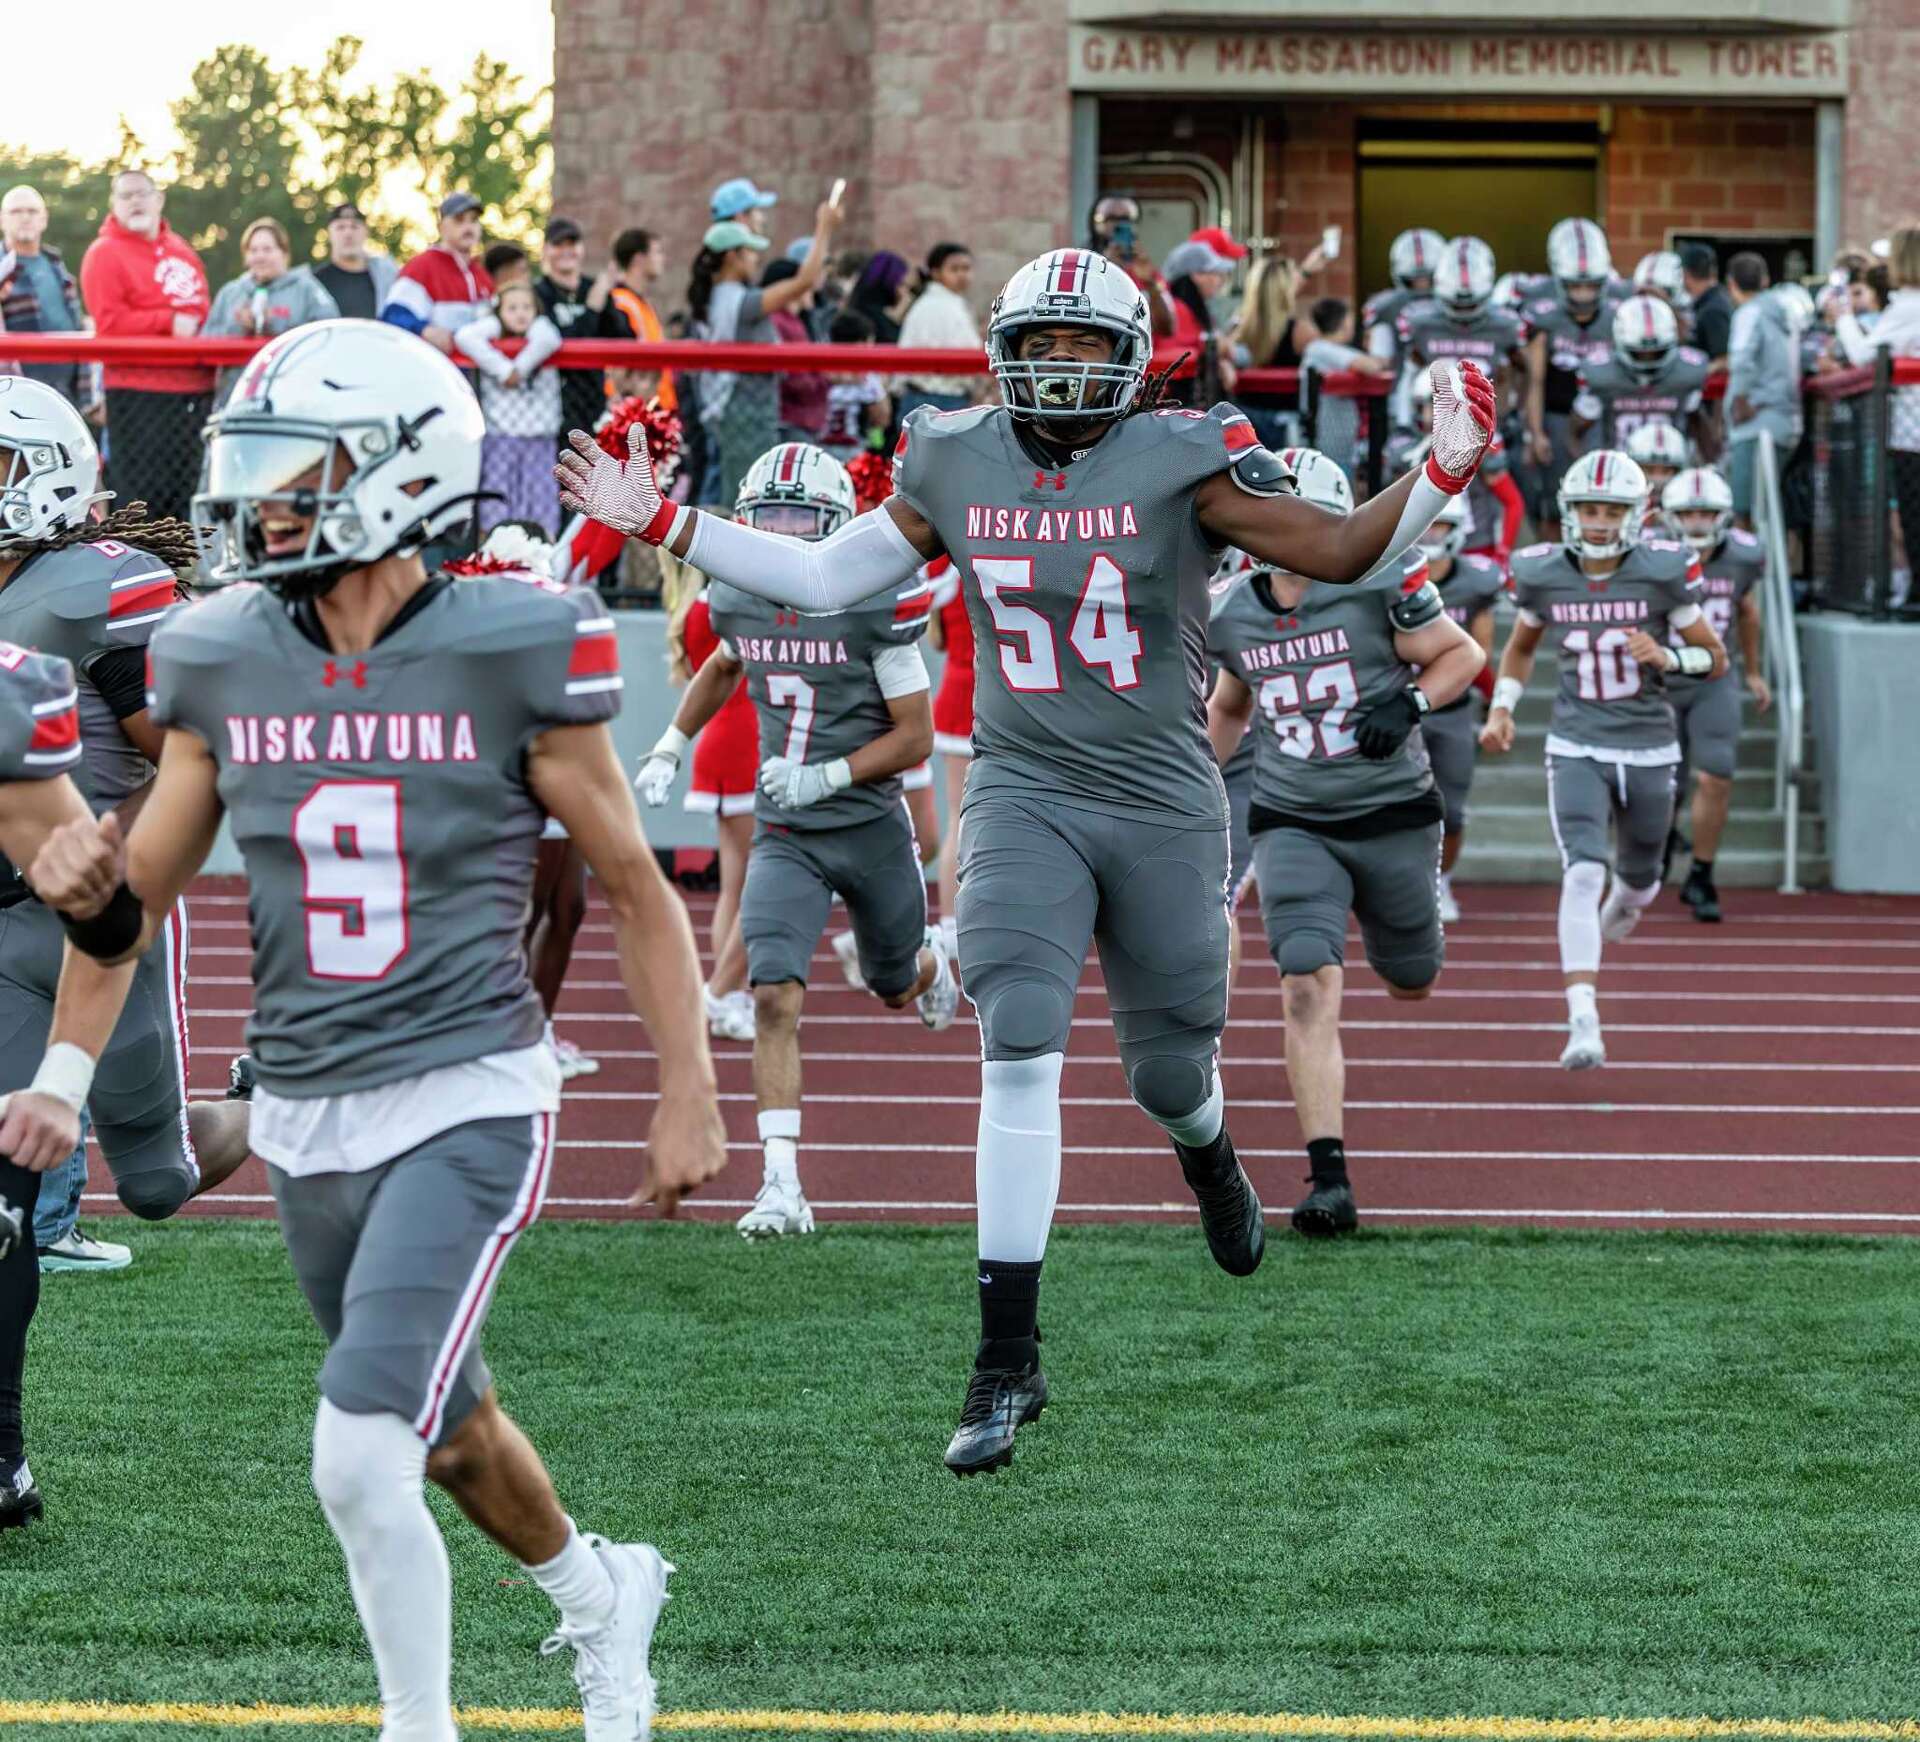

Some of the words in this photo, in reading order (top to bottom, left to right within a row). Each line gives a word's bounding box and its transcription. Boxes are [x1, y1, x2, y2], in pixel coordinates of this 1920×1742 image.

[1082, 35, 1196, 73] GARY
[1216, 37, 1451, 75] MASSARONI
[1470, 38, 1680, 77] MEMORIAL
[1705, 40, 1838, 78] TOWER
[966, 503, 1138, 542] NISKAYUNA
[970, 552, 1144, 693] 54
[1551, 600, 1648, 622] NISKAYUNA
[736, 635, 848, 664] NISKAYUNA
[1240, 627, 1350, 671] NISKAYUNA
[1562, 627, 1641, 700] 10
[766, 673, 816, 764] 7
[1259, 659, 1360, 759] 62
[226, 713, 478, 763] NISKAYUNA
[292, 779, 409, 980] 9
